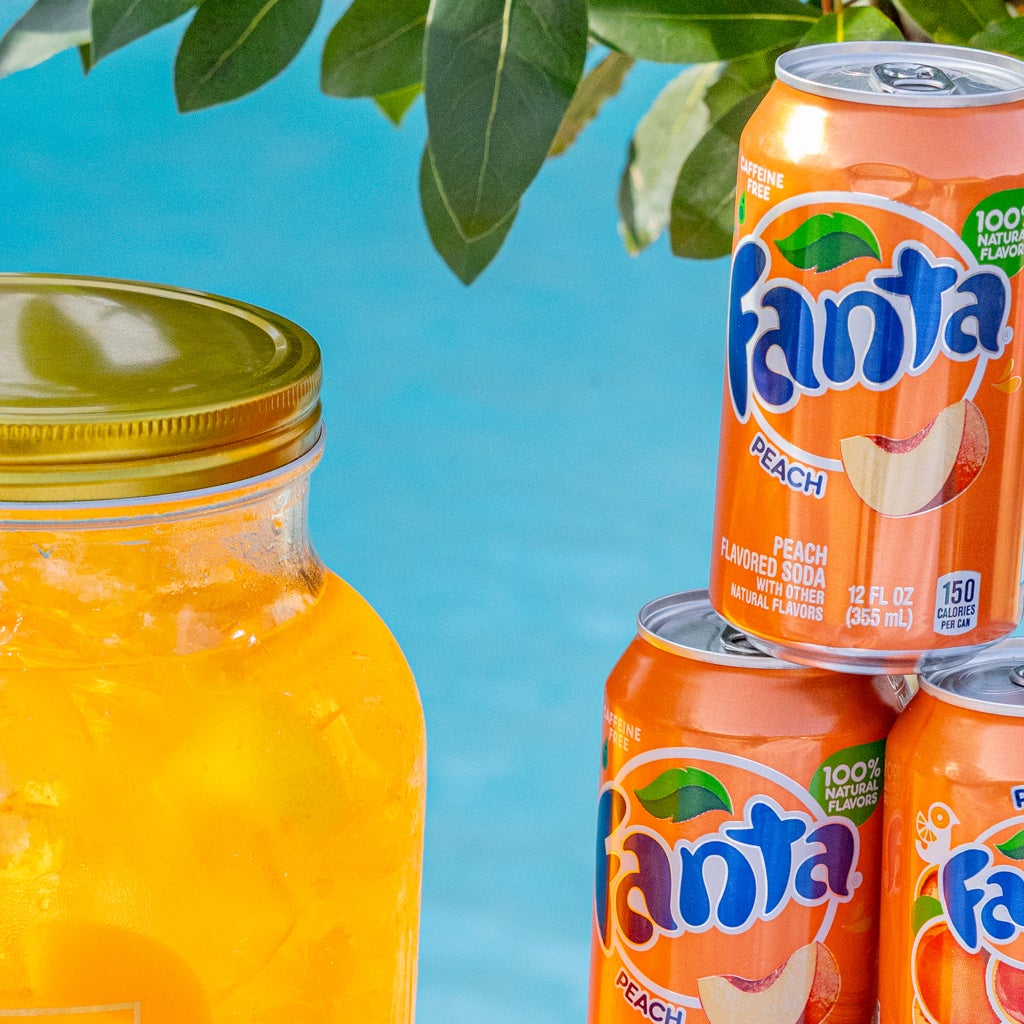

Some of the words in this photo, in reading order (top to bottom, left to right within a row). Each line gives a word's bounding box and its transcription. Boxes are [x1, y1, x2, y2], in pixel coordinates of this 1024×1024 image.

[740, 155, 784, 189] CAFFEINE
[747, 177, 770, 201] FREE
[728, 237, 1008, 420] Fanta
[750, 434, 825, 496] PEACH
[720, 536, 778, 578] FLAVORED
[781, 560, 826, 588] SODA
[773, 535, 828, 566] PEACH
[730, 582, 769, 610] NATURAL
[772, 597, 824, 622] FLAVORS
[756, 576, 783, 597] WITH
[785, 584, 825, 605] OTHER
[847, 585, 865, 605] 12
[869, 586, 888, 606] FL
[892, 586, 915, 606] OZ
[942, 578, 976, 605] 150
[845, 605, 881, 628] (355
[884, 608, 913, 631] mL)
[937, 604, 976, 619] CALORIES
[941, 619, 955, 630] PER
[957, 618, 970, 628] CAN
[608, 727, 629, 752] FREE
[823, 757, 881, 787] 100%
[825, 779, 879, 800] NATURAL
[828, 792, 878, 813] FLAVORS
